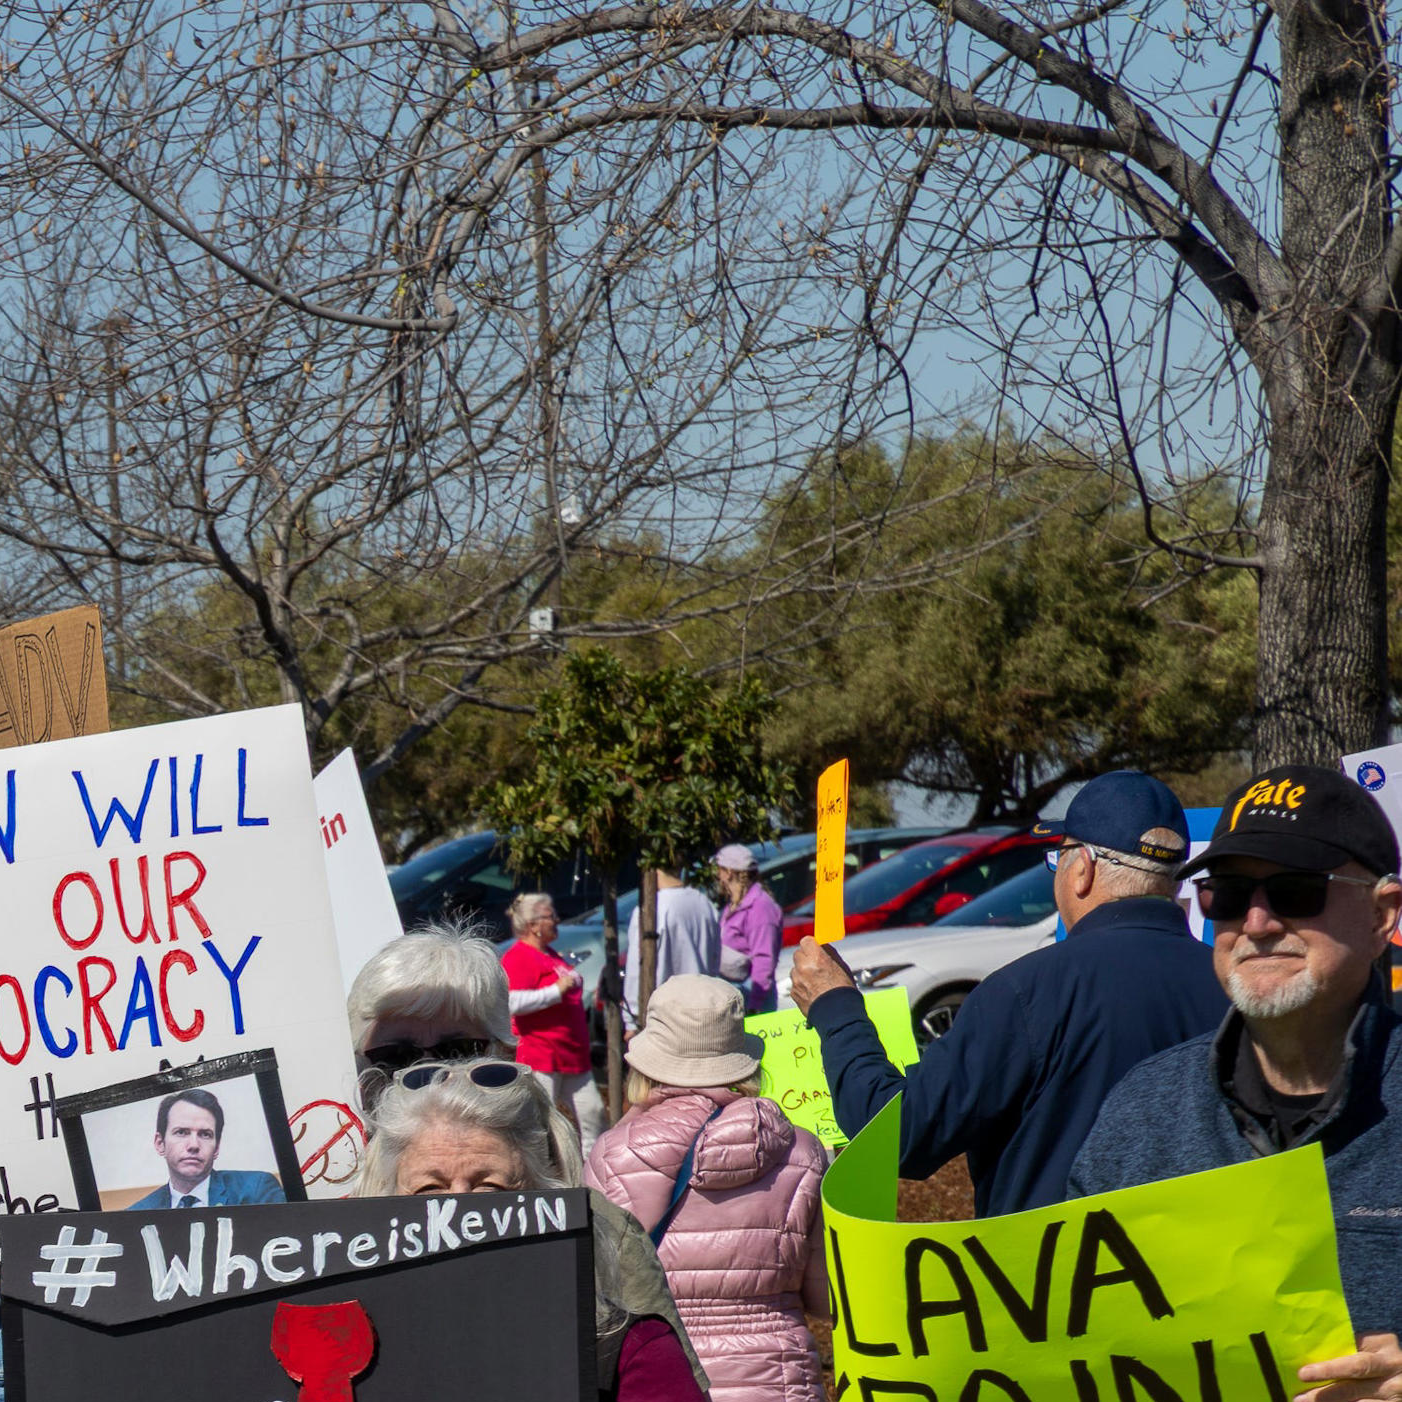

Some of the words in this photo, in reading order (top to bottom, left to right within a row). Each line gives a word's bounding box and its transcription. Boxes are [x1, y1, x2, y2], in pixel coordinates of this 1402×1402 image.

[71, 747, 270, 848] WILL
[52, 850, 213, 951] OUR
[828, 1208, 1175, 1358] LAVA
